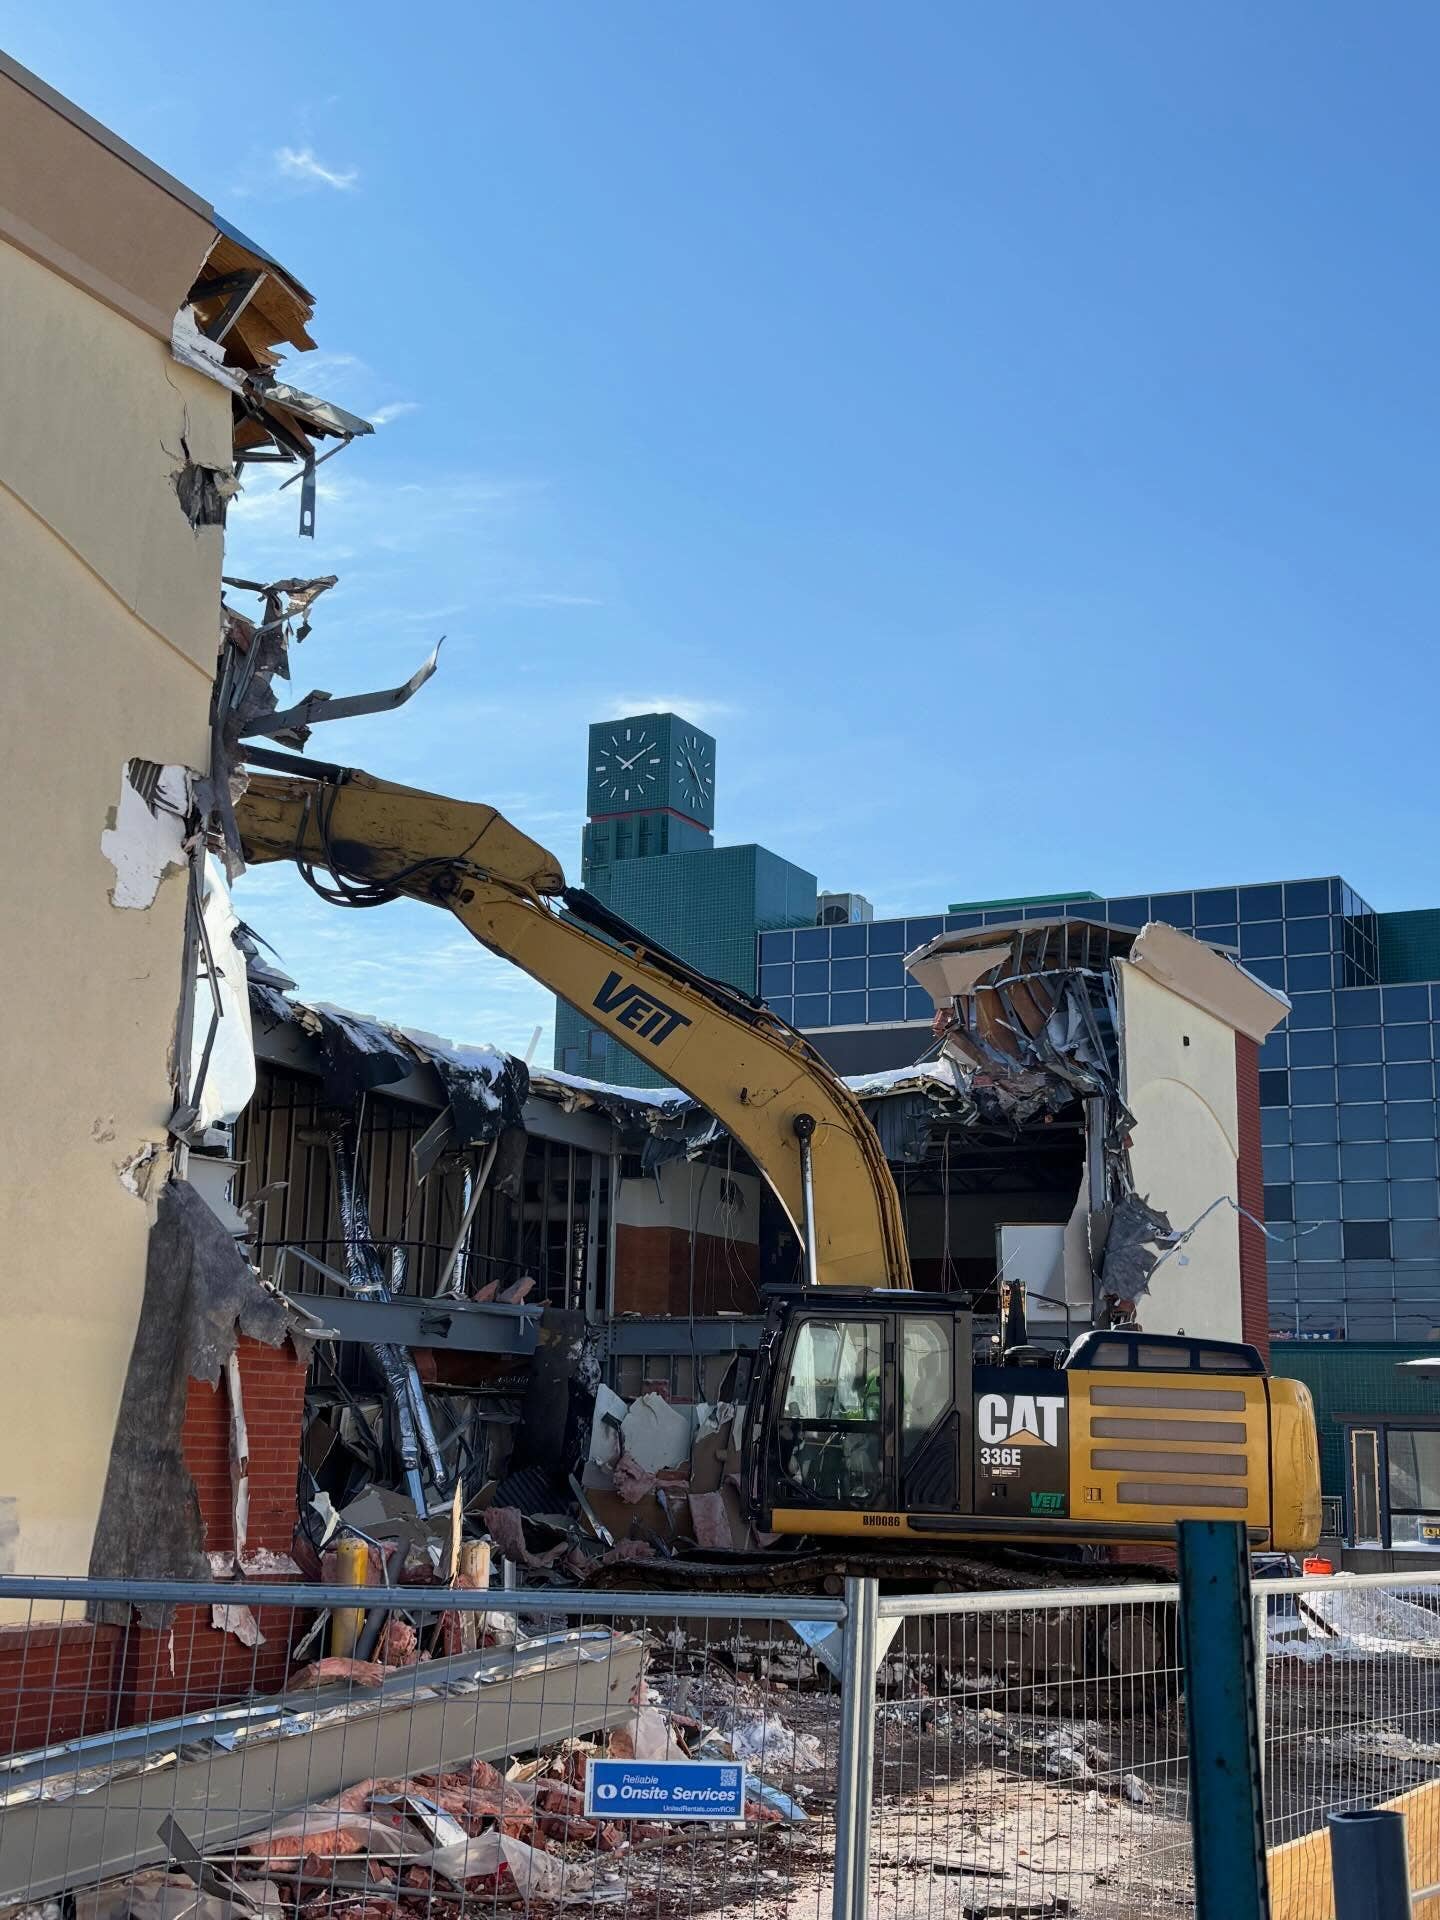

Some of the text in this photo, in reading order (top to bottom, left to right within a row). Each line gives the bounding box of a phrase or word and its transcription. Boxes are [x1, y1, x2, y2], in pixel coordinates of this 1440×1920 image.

[592, 970, 693, 1047] VEIT
[978, 1393, 1065, 1448] CAT
[980, 1447, 1021, 1466] 336E
[1030, 1491, 1065, 1509] VEIT
[622, 1774, 659, 1784] Reliable
[620, 1785, 736, 1801] Onsite Services
